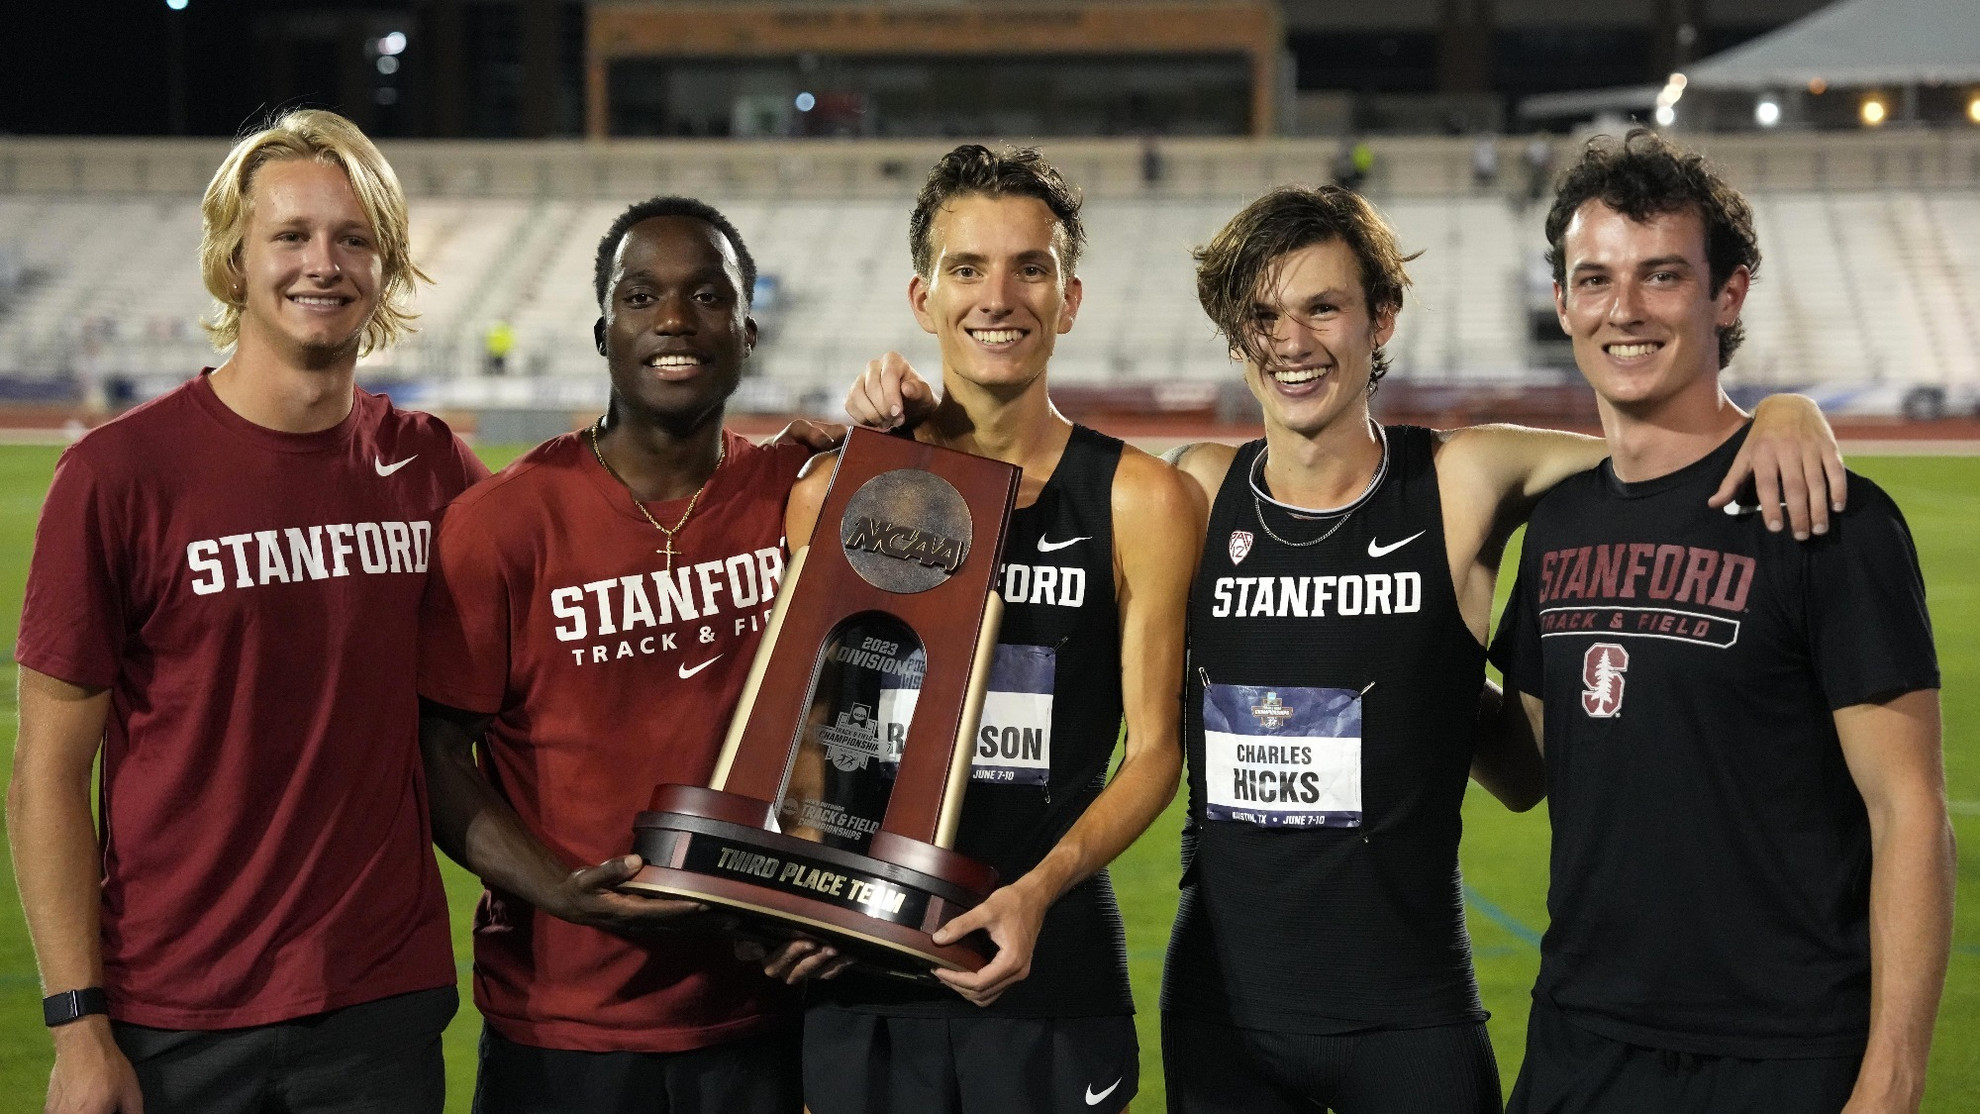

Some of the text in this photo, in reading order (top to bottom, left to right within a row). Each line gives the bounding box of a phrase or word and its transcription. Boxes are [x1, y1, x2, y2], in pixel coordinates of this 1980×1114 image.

[187, 521, 431, 595] STANFORD
[845, 515, 964, 576] NCAA
[1232, 545, 1244, 557] 12
[551, 536, 786, 642] STANFOR
[998, 563, 1086, 607] ORD
[1212, 572, 1421, 617] STANFORD
[1539, 543, 1756, 612] STANFORD
[1609, 612, 1623, 629] &
[1638, 613, 1710, 637] FIELD
[572, 632, 678, 666] TRACK
[699, 626, 716, 644] &
[837, 646, 907, 677] DIVISION
[861, 636, 899, 656] 2023
[973, 725, 1042, 761] SON
[1237, 744, 1312, 765] CHARLES
[973, 769, 1015, 780] JUNE 7-10
[1234, 768, 1320, 804] HICKS
[802, 803, 880, 835] TRACK & FIELD
[820, 801, 846, 812] OUTDOOR
[1257, 814, 1267, 824] TX
[1283, 815, 1307, 825] JUNE
[1307, 815, 1326, 825] 7-10
[716, 847, 906, 914] THIRD PLACE TEAM
